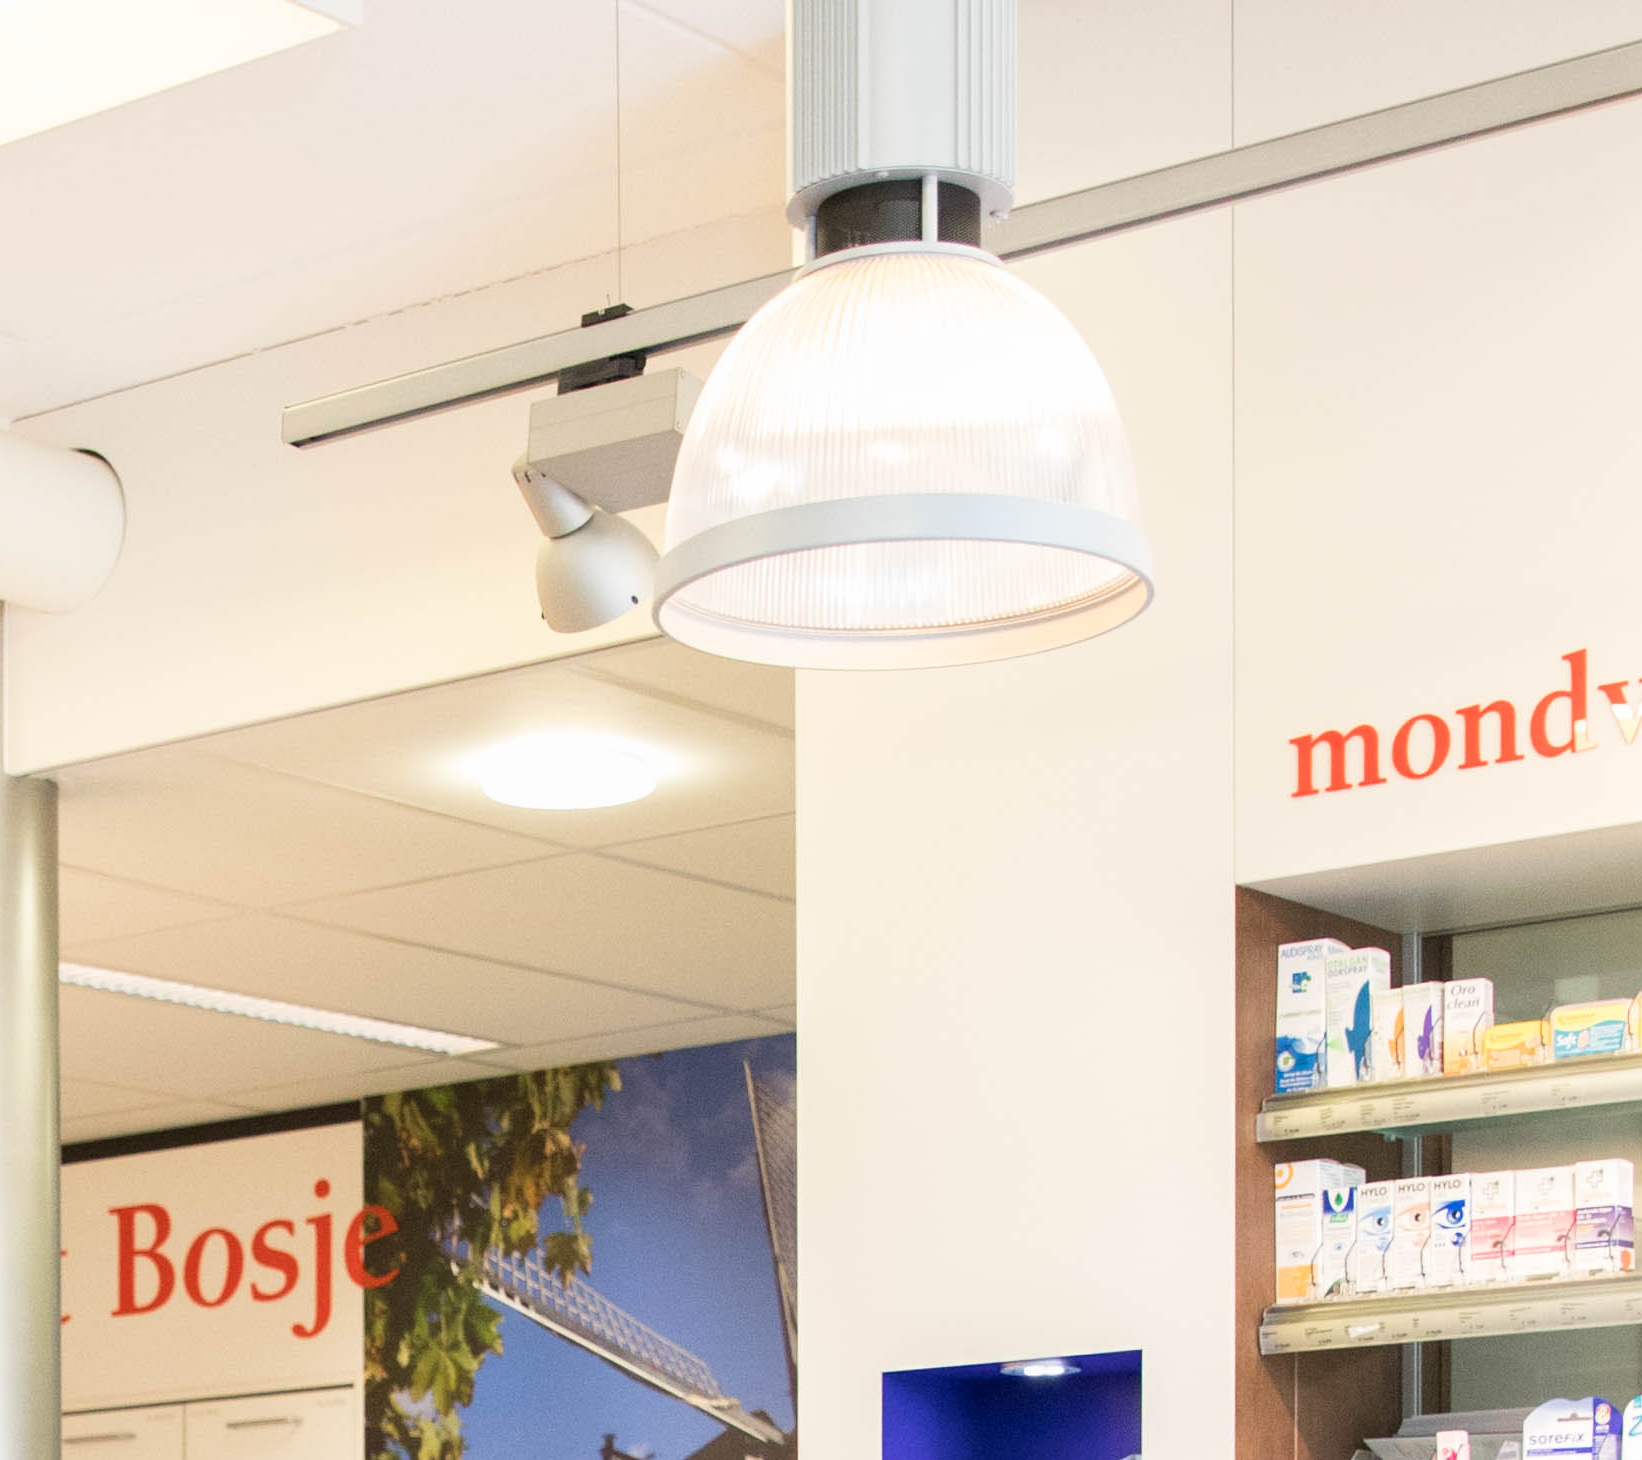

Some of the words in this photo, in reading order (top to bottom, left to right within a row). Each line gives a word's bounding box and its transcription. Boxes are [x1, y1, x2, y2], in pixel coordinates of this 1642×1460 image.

[1451, 983, 1476, 995] Oro
[1447, 996, 1480, 1010] clean
[1397, 1182, 1425, 1195] HYLO
[1433, 1177, 1462, 1191] HYLO
[1360, 1185, 1388, 1199] HYLO
[109, 1178, 402, 1341] Bosje
